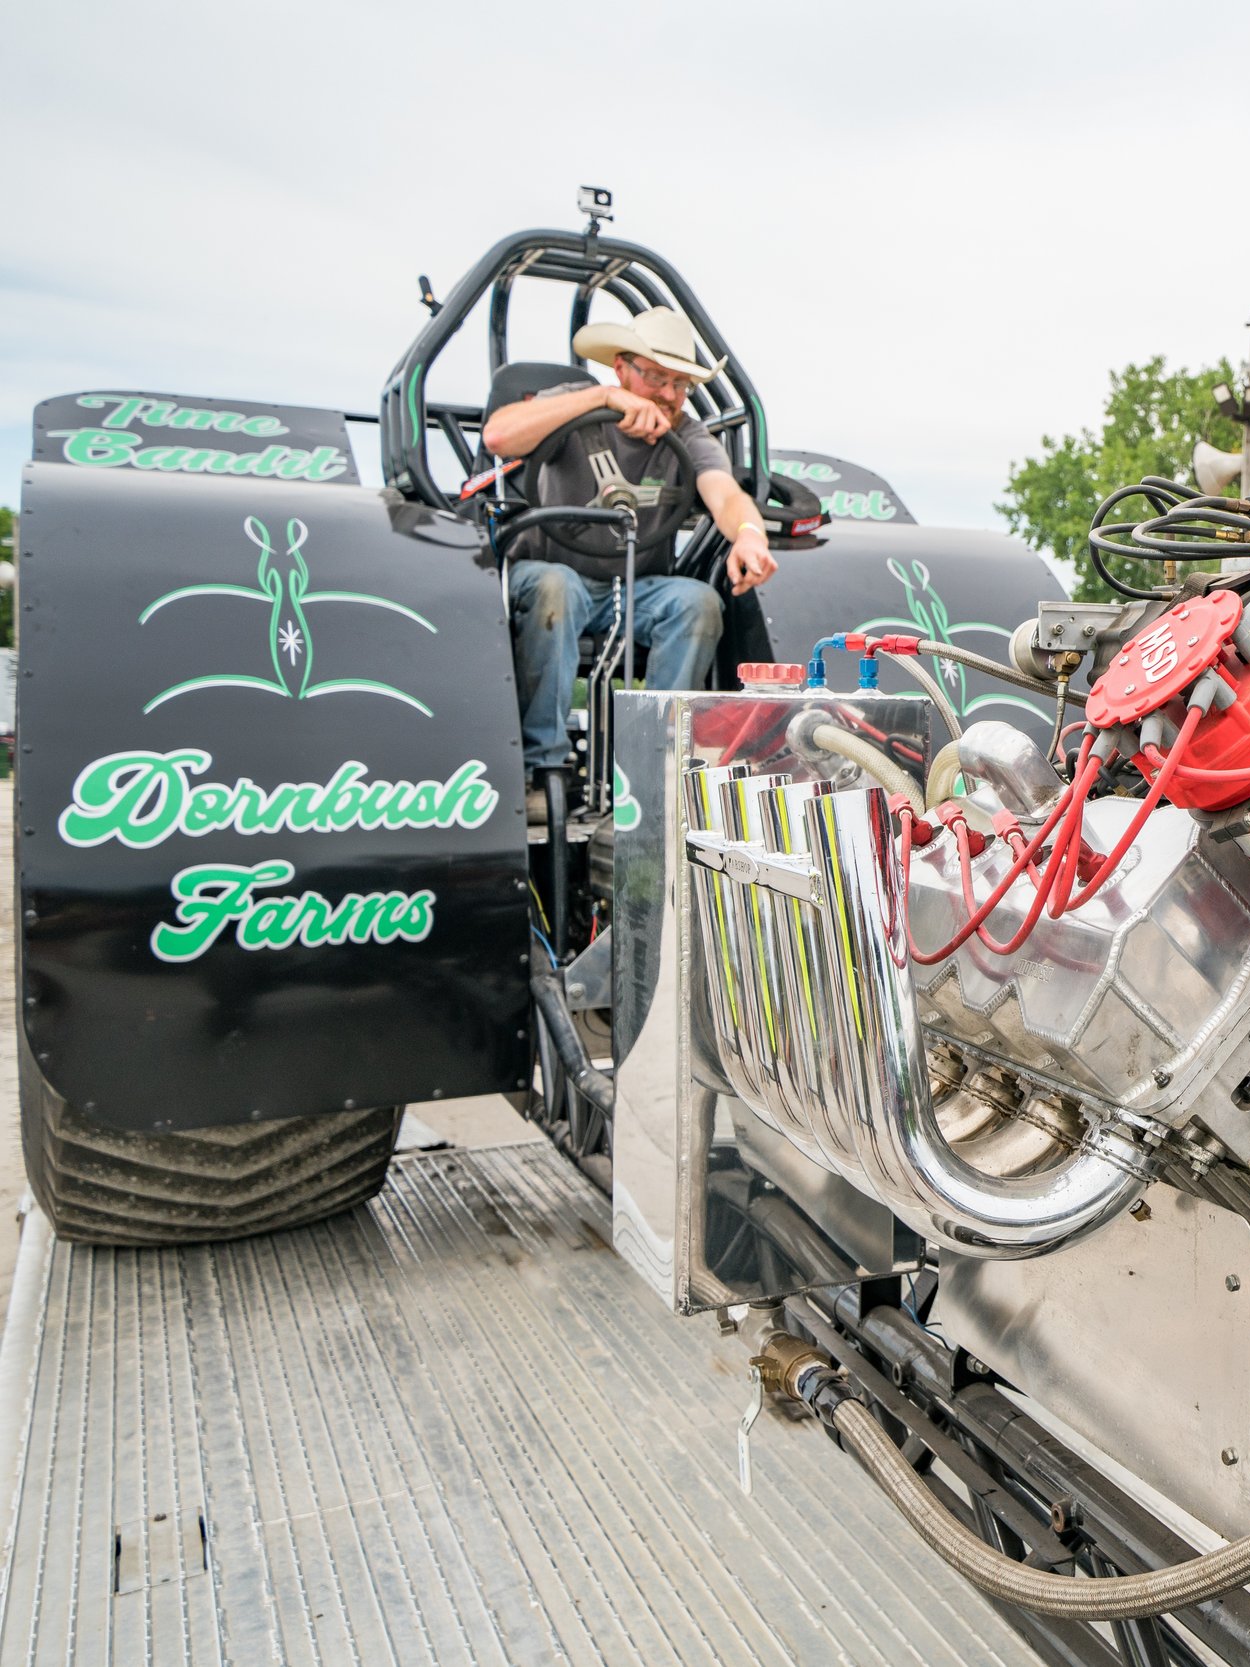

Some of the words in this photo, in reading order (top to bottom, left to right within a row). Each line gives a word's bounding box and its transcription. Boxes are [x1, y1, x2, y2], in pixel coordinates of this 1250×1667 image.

[77, 395, 289, 437] Time
[47, 427, 347, 481] Bandit
[1138, 622, 1178, 683] MSD
[58, 749, 498, 849] Dornbush
[151, 859, 436, 962] Farms
